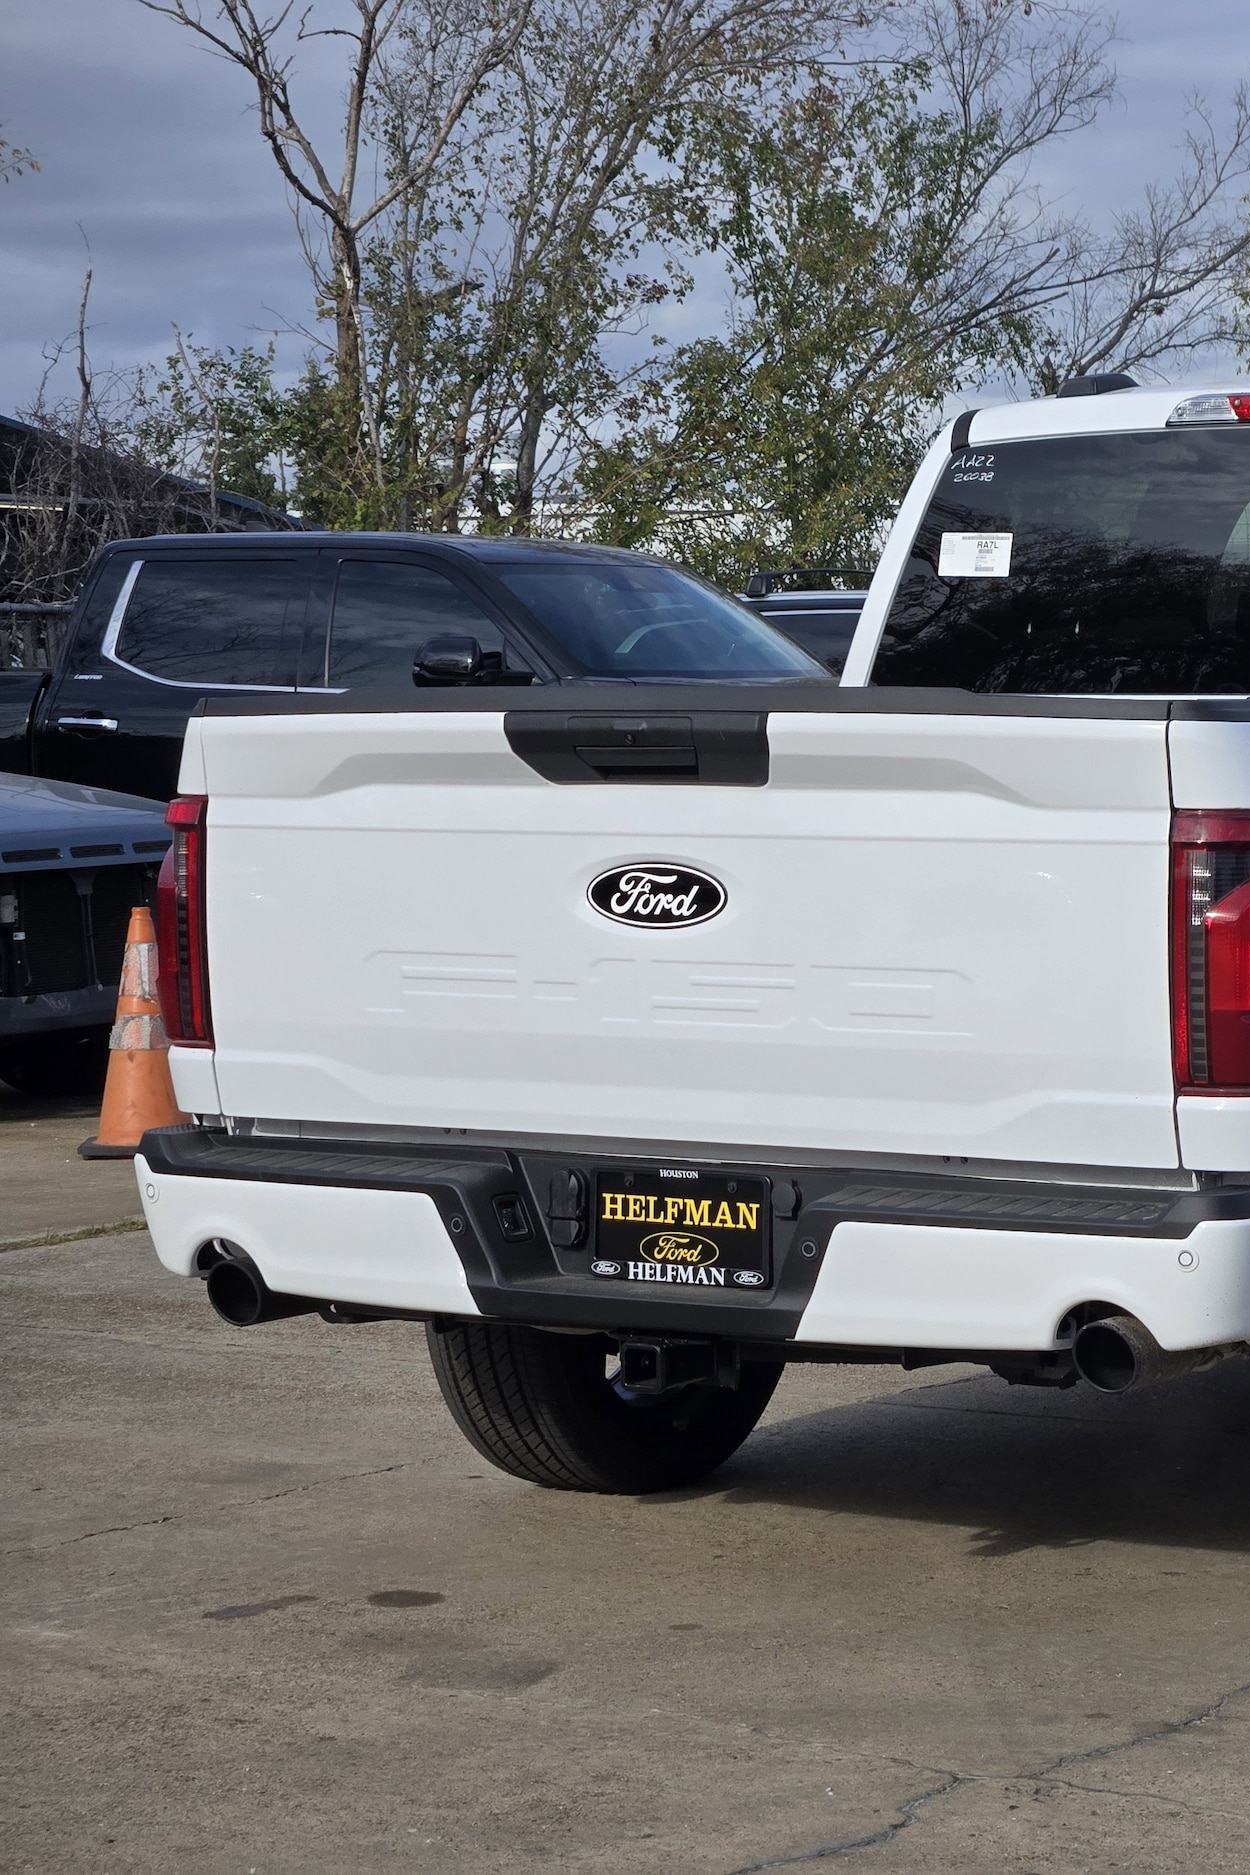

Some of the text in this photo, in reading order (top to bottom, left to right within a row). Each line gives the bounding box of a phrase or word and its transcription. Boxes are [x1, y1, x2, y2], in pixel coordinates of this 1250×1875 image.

[976, 540, 999, 549] RA7L
[610, 871, 700, 917] Ford
[659, 1169, 699, 1179] HOUSTON
[601, 1192, 761, 1230] HELFMAN
[653, 1235, 703, 1263] Ford
[627, 1261, 726, 1287] HELFMAN
